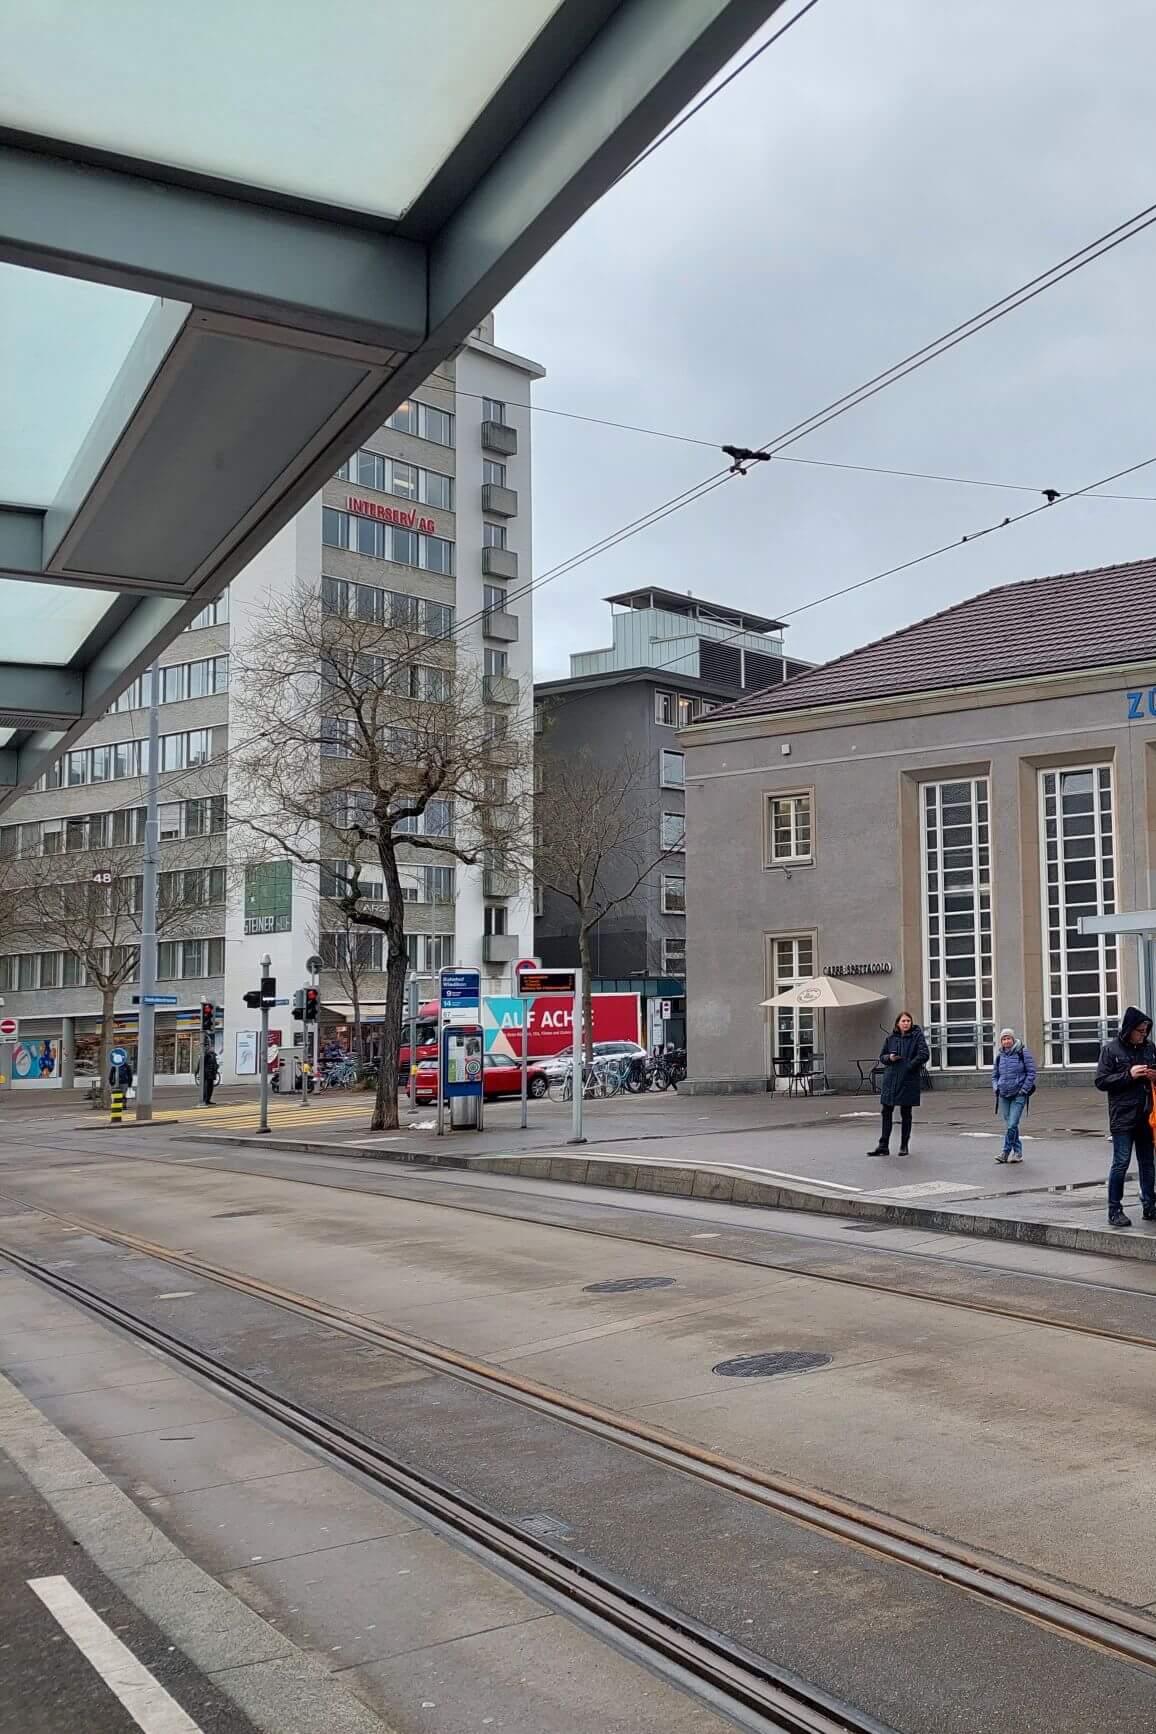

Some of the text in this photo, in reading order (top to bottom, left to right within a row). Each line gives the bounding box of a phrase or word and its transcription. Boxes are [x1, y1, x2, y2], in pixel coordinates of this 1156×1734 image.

[347, 496, 435, 534] INTERSERV AG
[93, 872, 111, 883] 48
